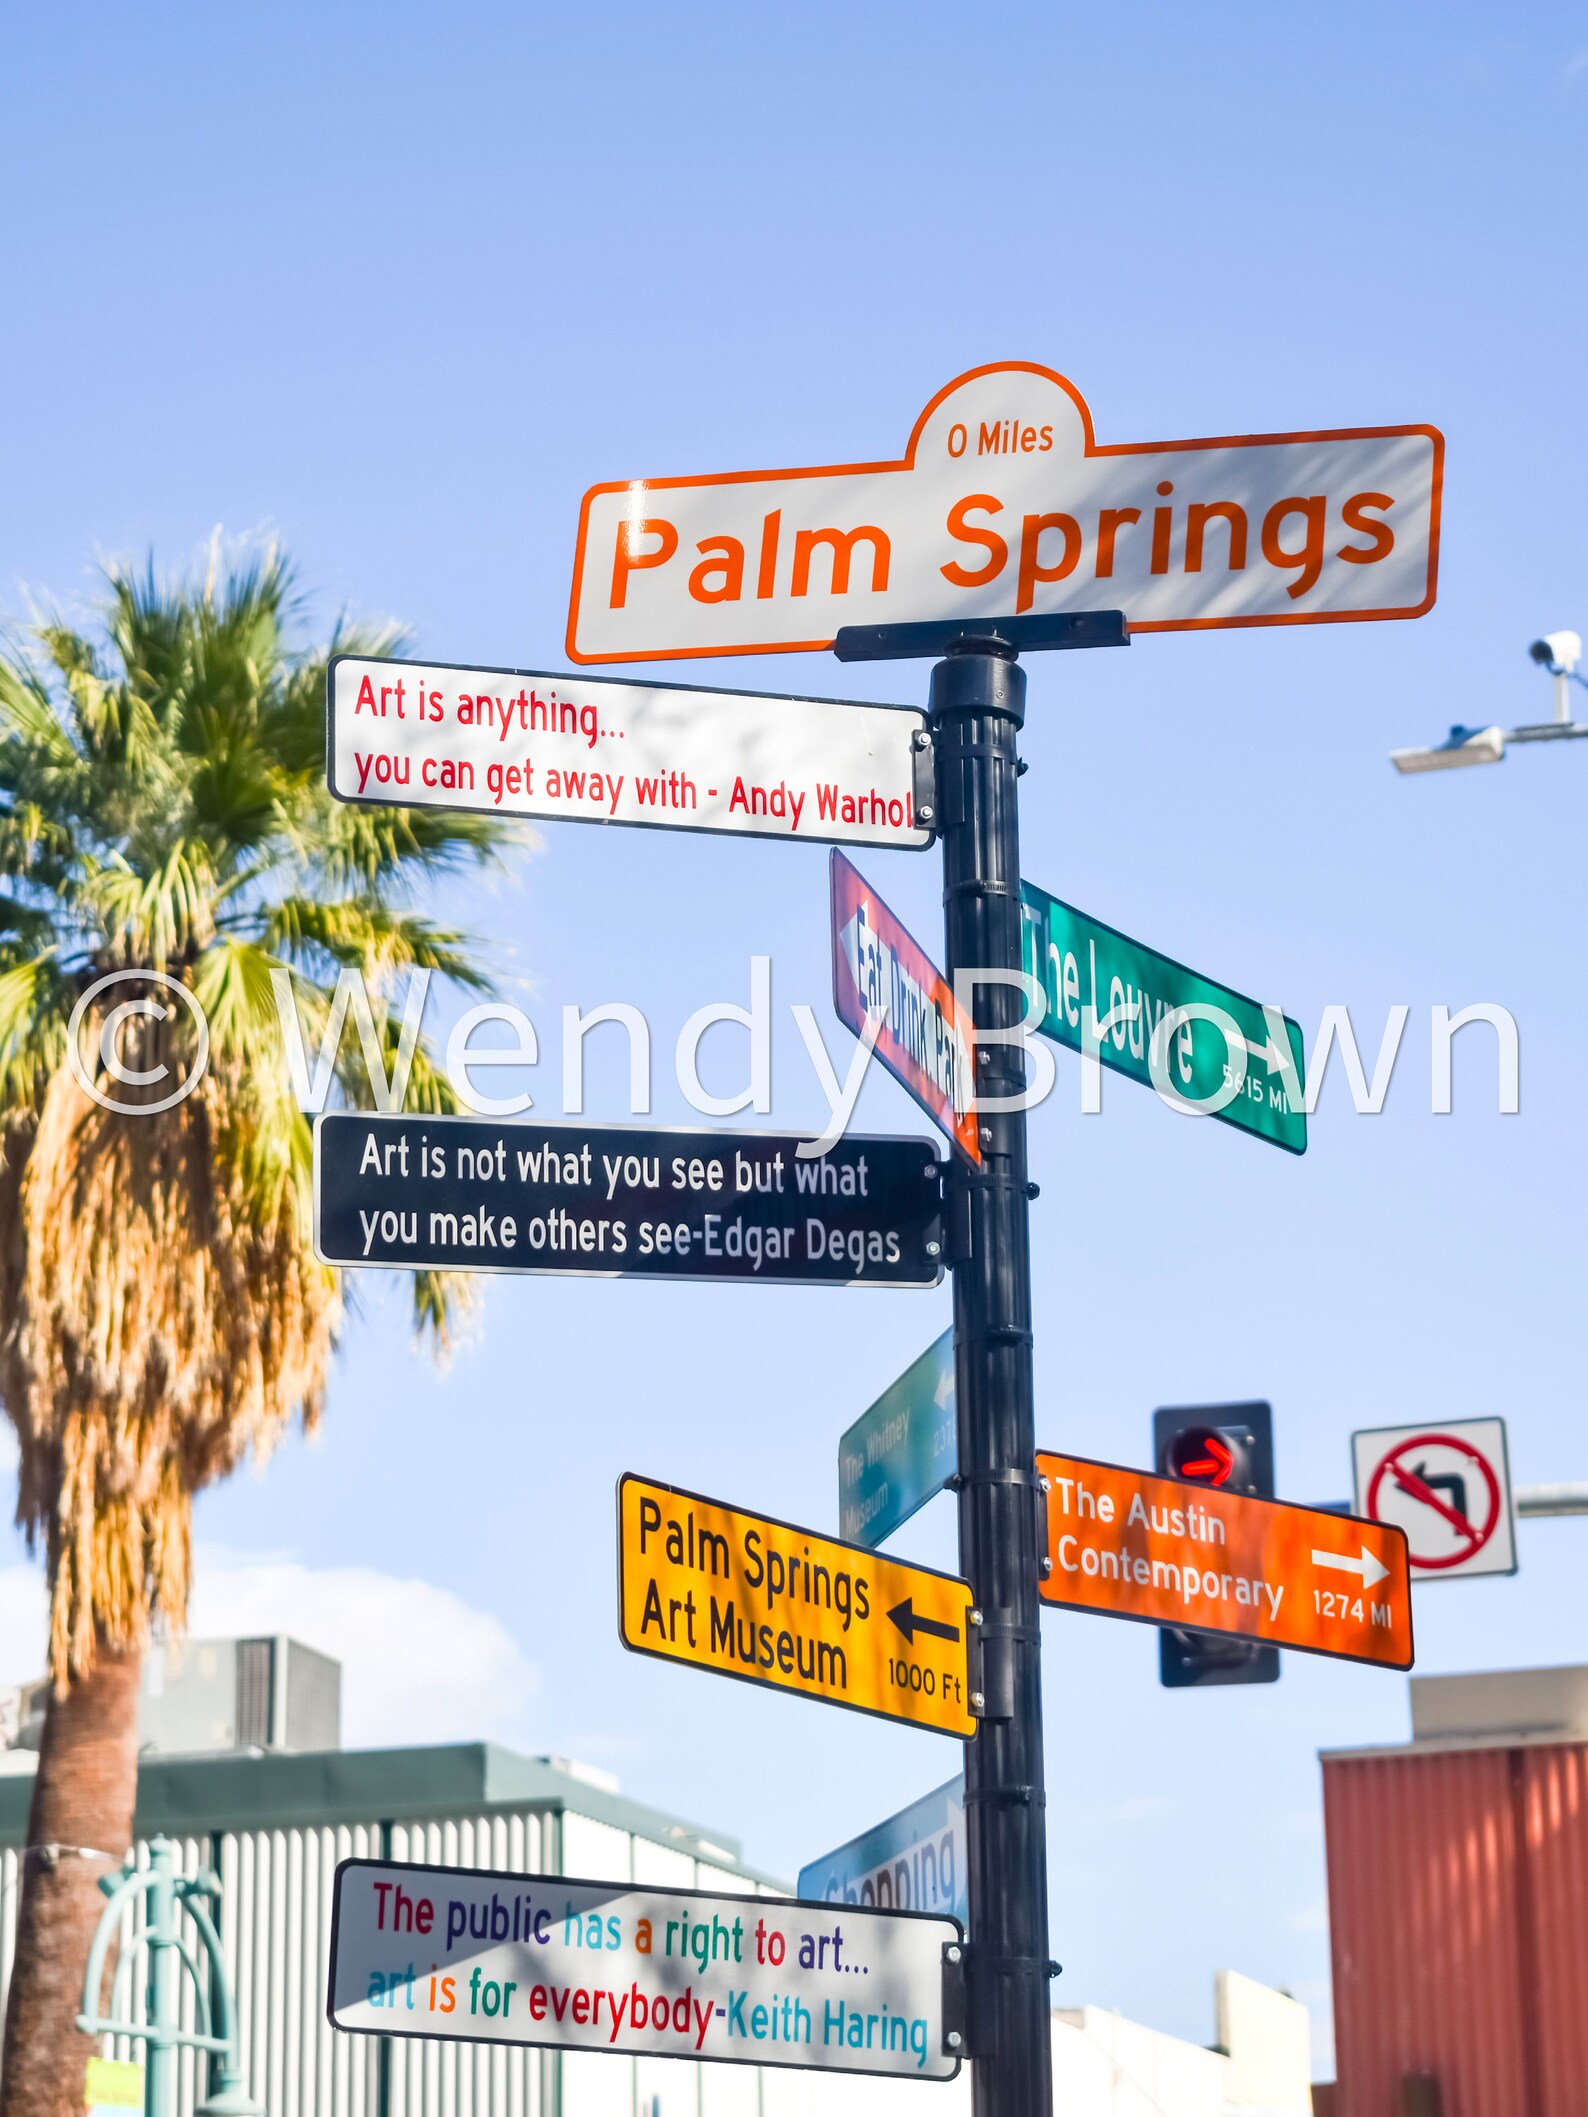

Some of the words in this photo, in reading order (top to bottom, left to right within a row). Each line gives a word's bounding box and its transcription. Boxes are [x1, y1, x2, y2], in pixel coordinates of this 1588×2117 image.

[977, 421, 1054, 457] Miles
[610, 508, 892, 610] Palm
[940, 481, 1396, 615] Springs
[355, 674, 406, 719] Art
[419, 680, 444, 722] is
[456, 692, 626, 748] anything...
[354, 752, 410, 793] you
[421, 759, 476, 789] can
[487, 758, 533, 804] get
[546, 769, 624, 815] away
[634, 770, 698, 809] with
[729, 776, 804, 830] Andy
[816, 783, 912, 829] Warhol
[1022, 902, 1080, 1028] The
[1089, 938, 1194, 1084] Louvre
[1222, 1064, 1264, 1103] 5615
[1269, 1086, 1287, 1115] MI
[359, 1133, 409, 1178] Art
[421, 1136, 447, 1179] is
[456, 1140, 507, 1182] not
[517, 1140, 593, 1187] what
[603, 1153, 661, 1200] you
[671, 1155, 724, 1192] see
[735, 1150, 786, 1194] but
[794, 1156, 870, 1198] what
[359, 1209, 419, 1256] you
[429, 1205, 518, 1250] make
[528, 1209, 628, 1255] others
[806, 1223, 902, 1275] Degas
[845, 1451, 866, 1488] The
[866, 1405, 911, 1469] Whitney
[1055, 1476, 1116, 1523] The
[1126, 1492, 1226, 1546] Austin
[639, 1495, 730, 1579] Palm
[744, 1530, 871, 1634] Springs
[1057, 1535, 1285, 1622] Contemporary
[640, 1578, 697, 1649] Art
[710, 1595, 848, 1690] Museum
[1312, 1588, 1365, 1625] 1274
[1370, 1603, 1393, 1630] MI
[888, 1657, 936, 1697] 1000
[942, 1673, 962, 1704] Ft
[373, 1883, 434, 1936] The
[446, 1892, 552, 1952] public
[563, 1904, 622, 1952] has
[634, 1918, 653, 1955] a
[664, 1910, 744, 1974] right
[755, 1918, 786, 1966] to
[798, 1926, 870, 1975] art...
[368, 1962, 416, 2011] art
[428, 1962, 457, 2013] is
[469, 1966, 517, 2018] for
[823, 1999, 928, 2070] Haring
